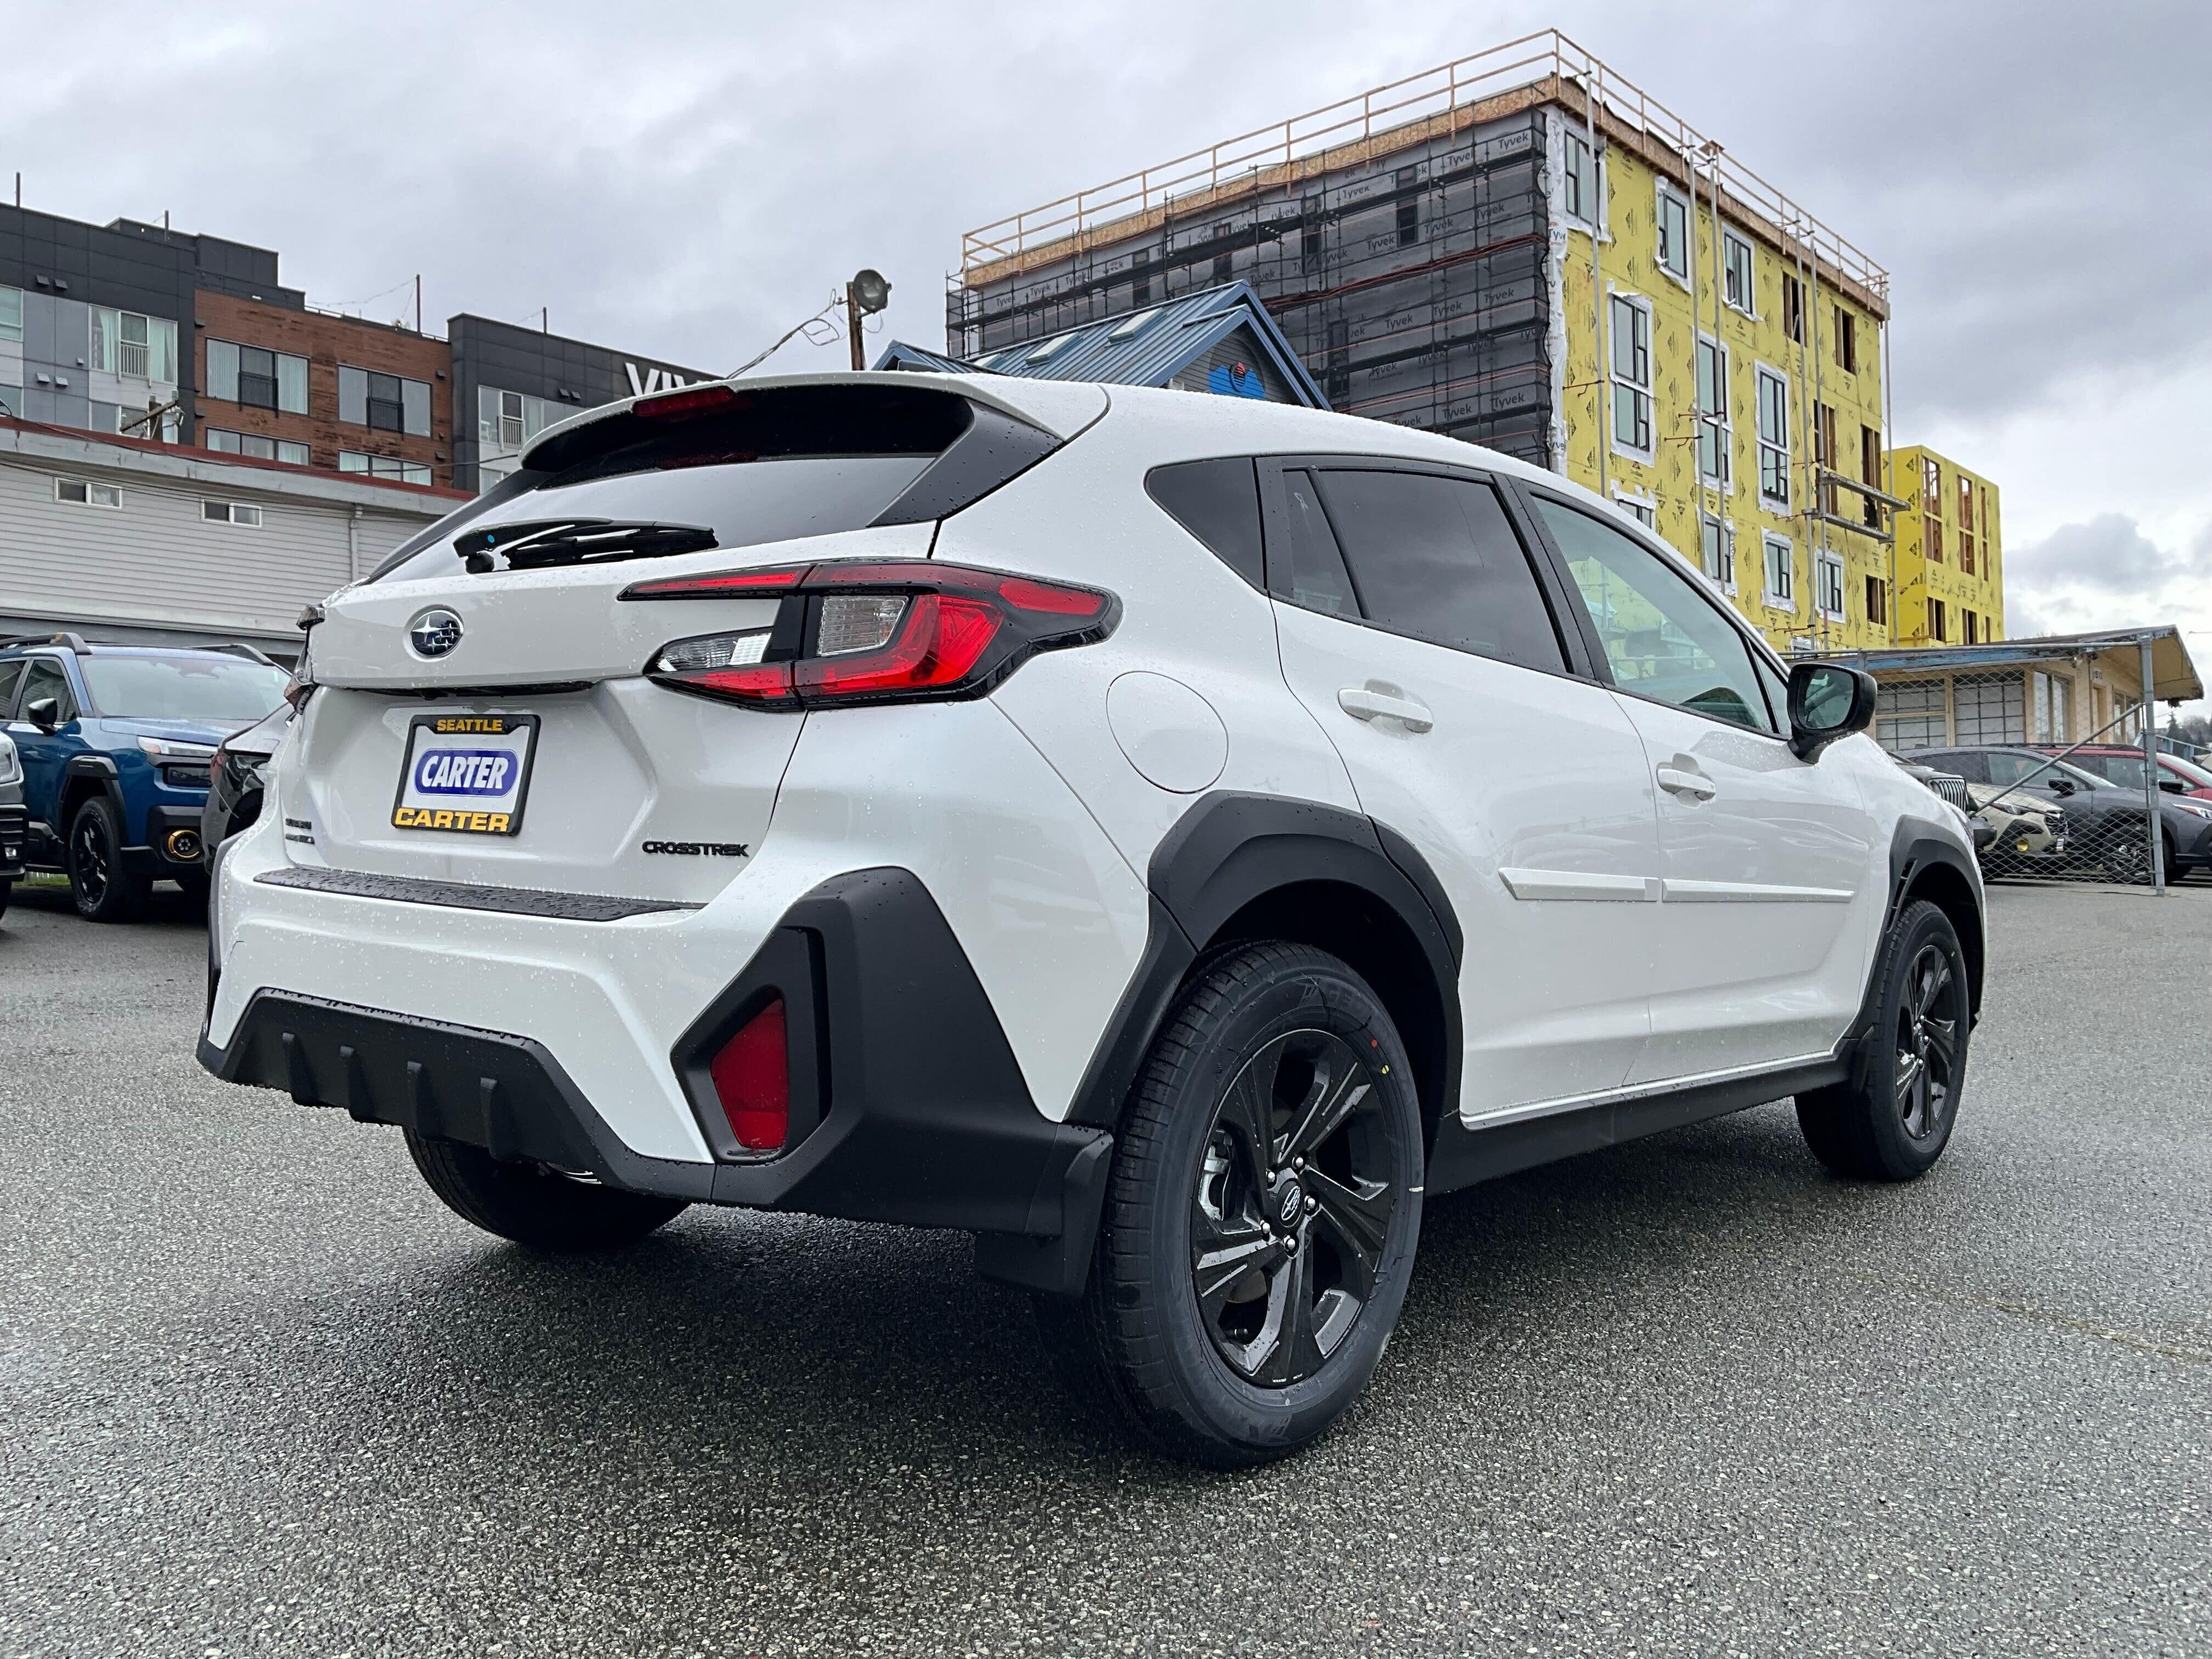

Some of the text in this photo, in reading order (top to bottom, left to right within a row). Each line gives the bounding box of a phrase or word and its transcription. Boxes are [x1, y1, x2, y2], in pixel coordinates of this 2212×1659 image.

[1498, 132, 1528, 150] Tyvek
[1367, 235, 1395, 251] Tyvek
[1484, 288, 1514, 303] Tyvek
[1434, 301, 1462, 317] Tyvek
[1385, 314, 1413, 330] Tyvek
[1494, 392, 1525, 408] Tyvek
[1442, 403, 1472, 420] Tyvek
[437, 719, 503, 732] SEATTLE
[421, 755, 509, 789] CARTER
[394, 808, 510, 832] CARTER
[642, 841, 749, 857] CROSSTREK
